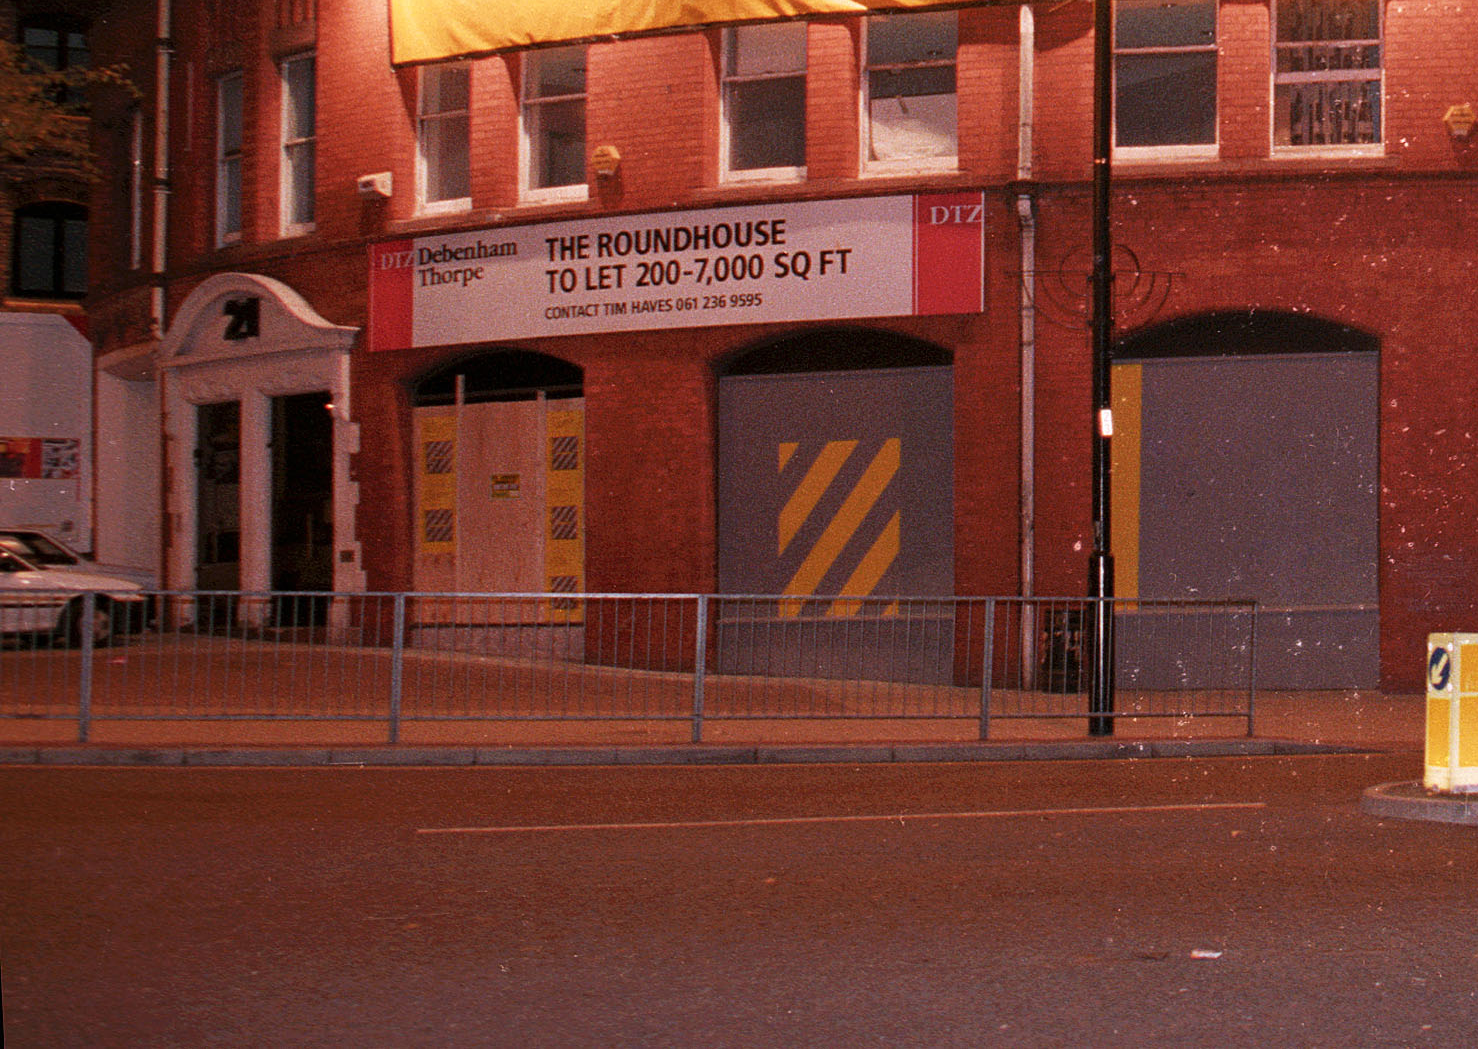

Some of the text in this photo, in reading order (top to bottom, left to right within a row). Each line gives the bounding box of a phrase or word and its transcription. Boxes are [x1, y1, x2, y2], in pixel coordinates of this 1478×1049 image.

[929, 204, 983, 225] DTZ
[418, 240, 518, 266] Debenham
[545, 218, 787, 262] THE ROUNDHOUSE
[380, 250, 415, 270] DTZ
[545, 248, 852, 294] TO LET 200-7,000 SQ FT
[418, 266, 485, 287] Thorpe
[544, 292, 763, 320] CONTACT TIM HAVES 061 236 9595
